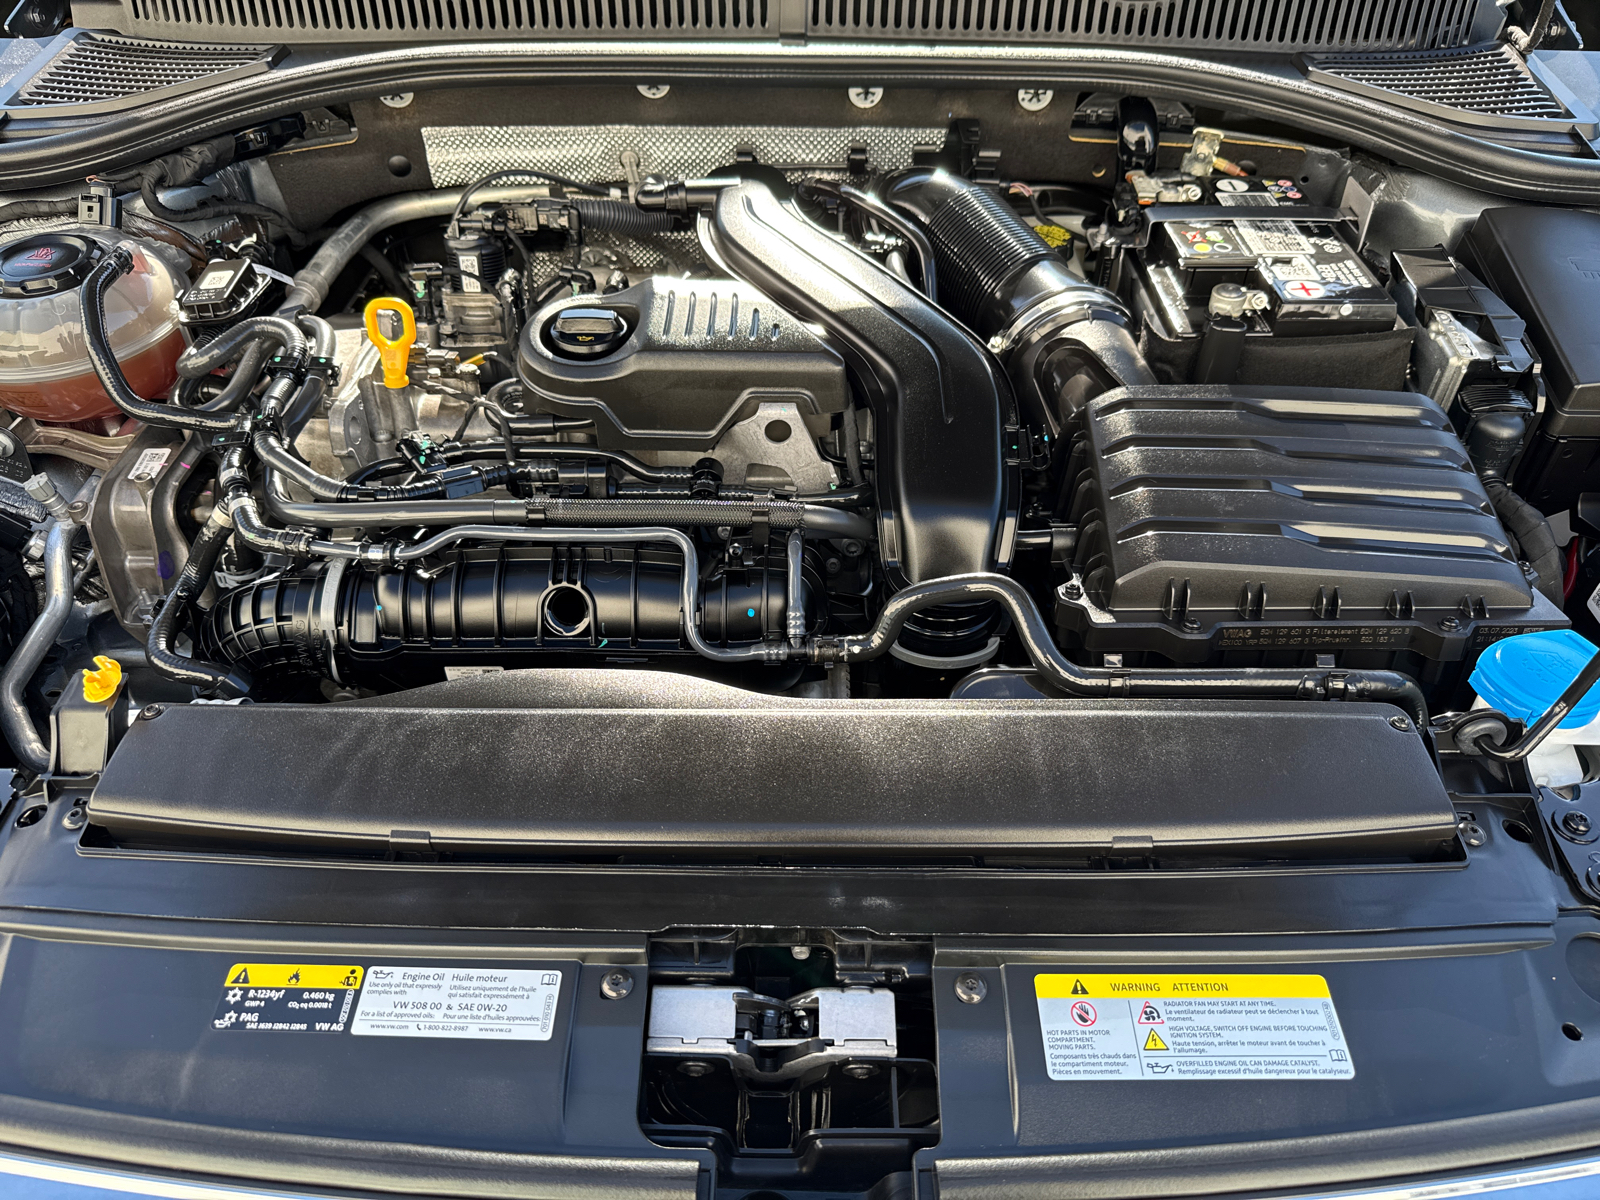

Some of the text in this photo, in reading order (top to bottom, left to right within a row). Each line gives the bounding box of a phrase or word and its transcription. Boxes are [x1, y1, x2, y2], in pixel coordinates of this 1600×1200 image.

[1223, 629, 1252, 638] VWAG
[402, 972, 445, 982] Engine Oil
[452, 973, 474, 982] Huile
[381, 981, 393, 989] only
[415, 983, 442, 991] expressly
[1110, 983, 1161, 992] WARNING
[1172, 983, 1229, 992] ATTENTION
[248, 989, 285, 1000] R-1234yf
[302, 991, 335, 1002] 0.460 kg
[393, 1001, 409, 1009] VW
[410, 1001, 428, 1010] 508
[429, 1002, 442, 1010] 00
[457, 1003, 475, 1011] SAE
[240, 1013, 259, 1022] PAG
[393, 1011, 421, 1020] approved
[315, 1023, 345, 1031] VW AG
[1192, 1040, 1217, 1048] tension,
[1178, 1068, 1216, 1076] Remplissage
[1264, 1068, 1296, 1076] dangereux
[1318, 1068, 1351, 1076] catalyseur.
